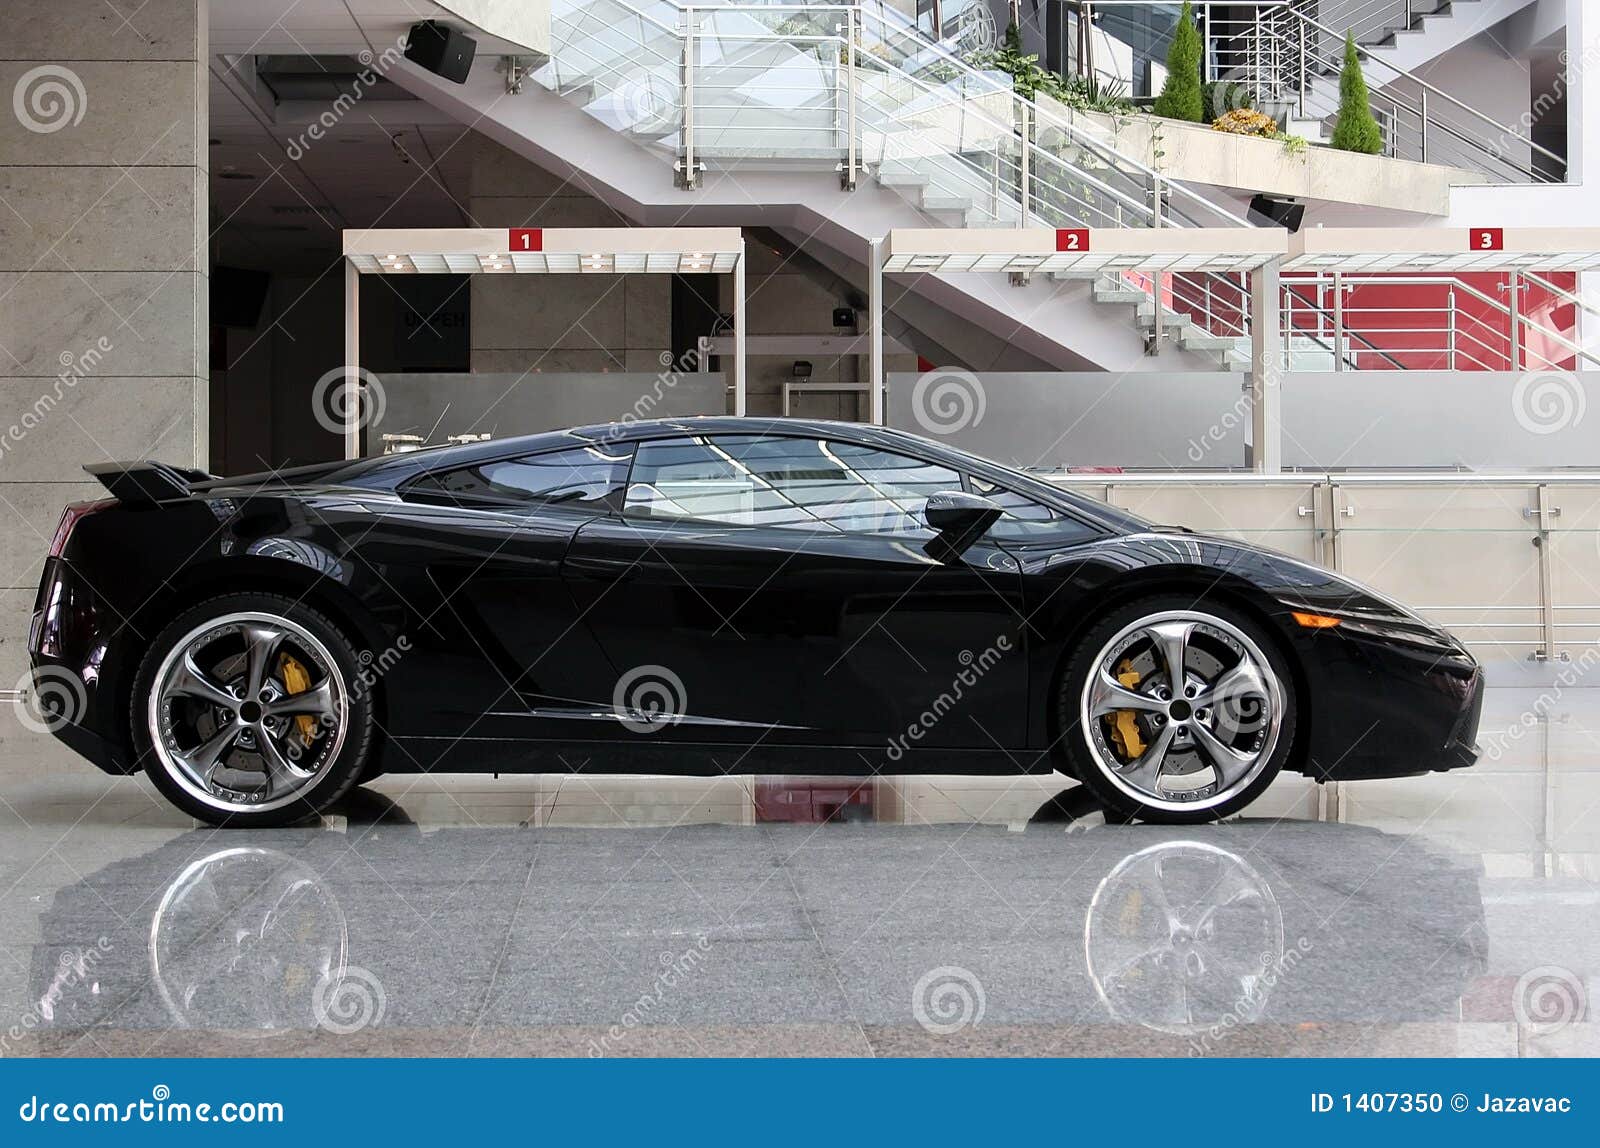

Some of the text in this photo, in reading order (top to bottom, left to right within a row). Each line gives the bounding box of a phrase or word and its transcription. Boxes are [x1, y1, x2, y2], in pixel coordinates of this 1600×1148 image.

[521, 233, 530, 249] 1
[1067, 233, 1079, 250] 2
[1480, 232, 1493, 249] 3
